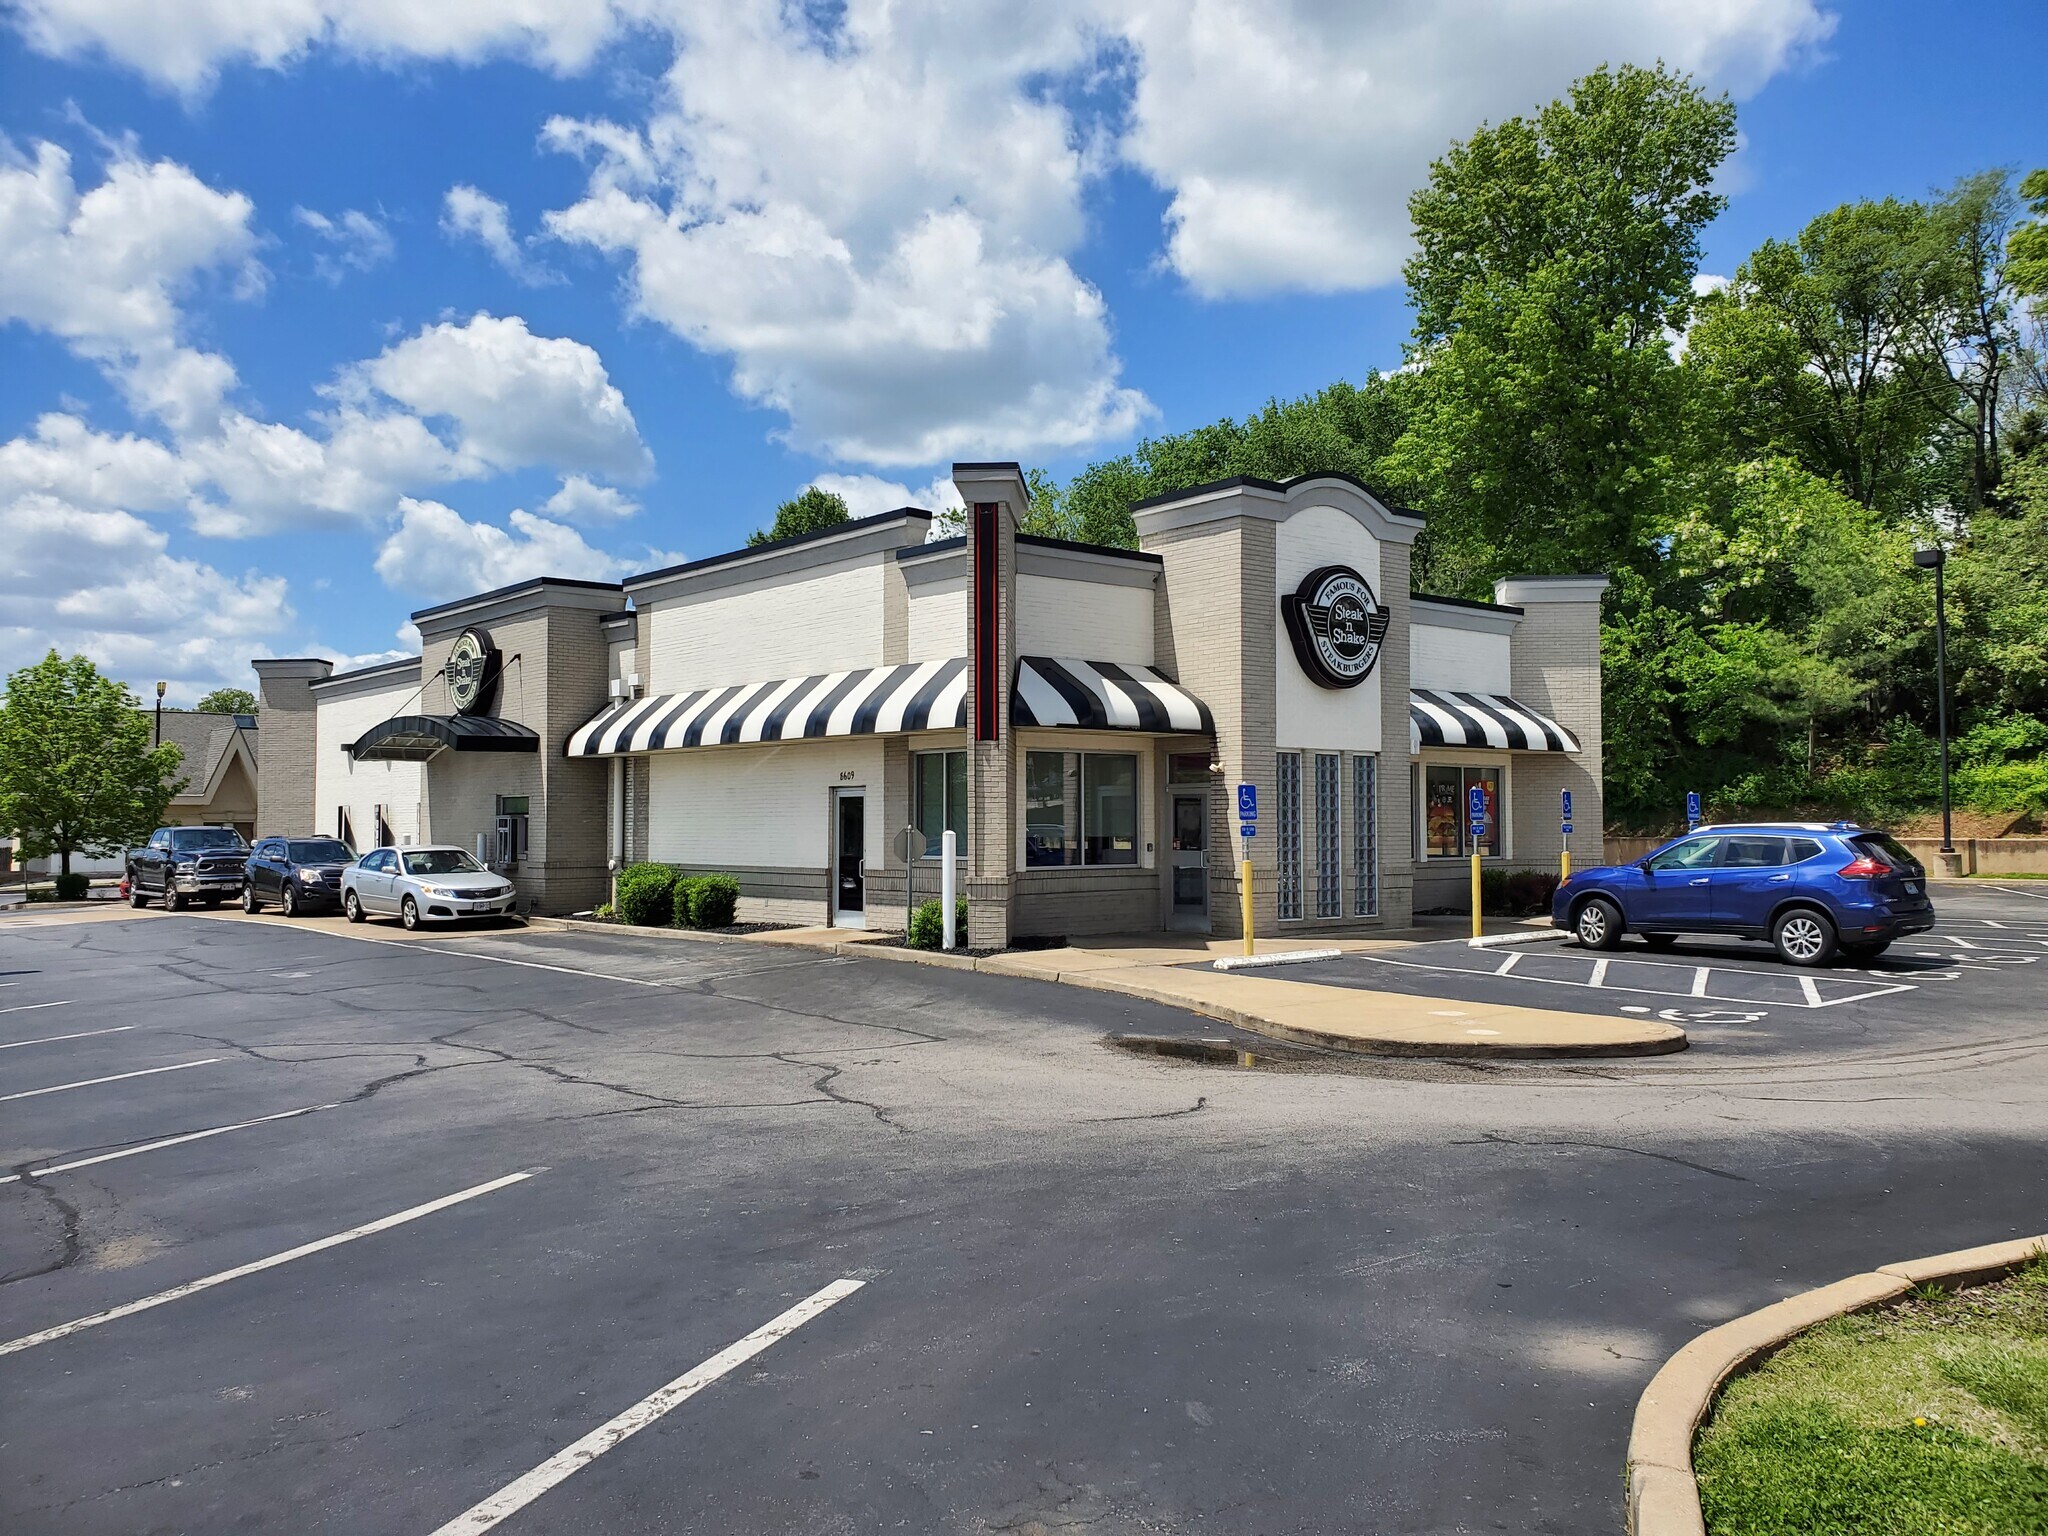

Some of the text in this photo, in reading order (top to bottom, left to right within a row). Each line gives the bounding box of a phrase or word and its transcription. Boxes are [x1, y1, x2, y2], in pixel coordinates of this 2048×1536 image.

[1325, 581, 1370, 606] FAMOUS FOR
[1335, 604, 1364, 621] Steak
[1333, 628, 1365, 645] Shake
[1321, 640, 1374, 672] STEAKBURGERS
